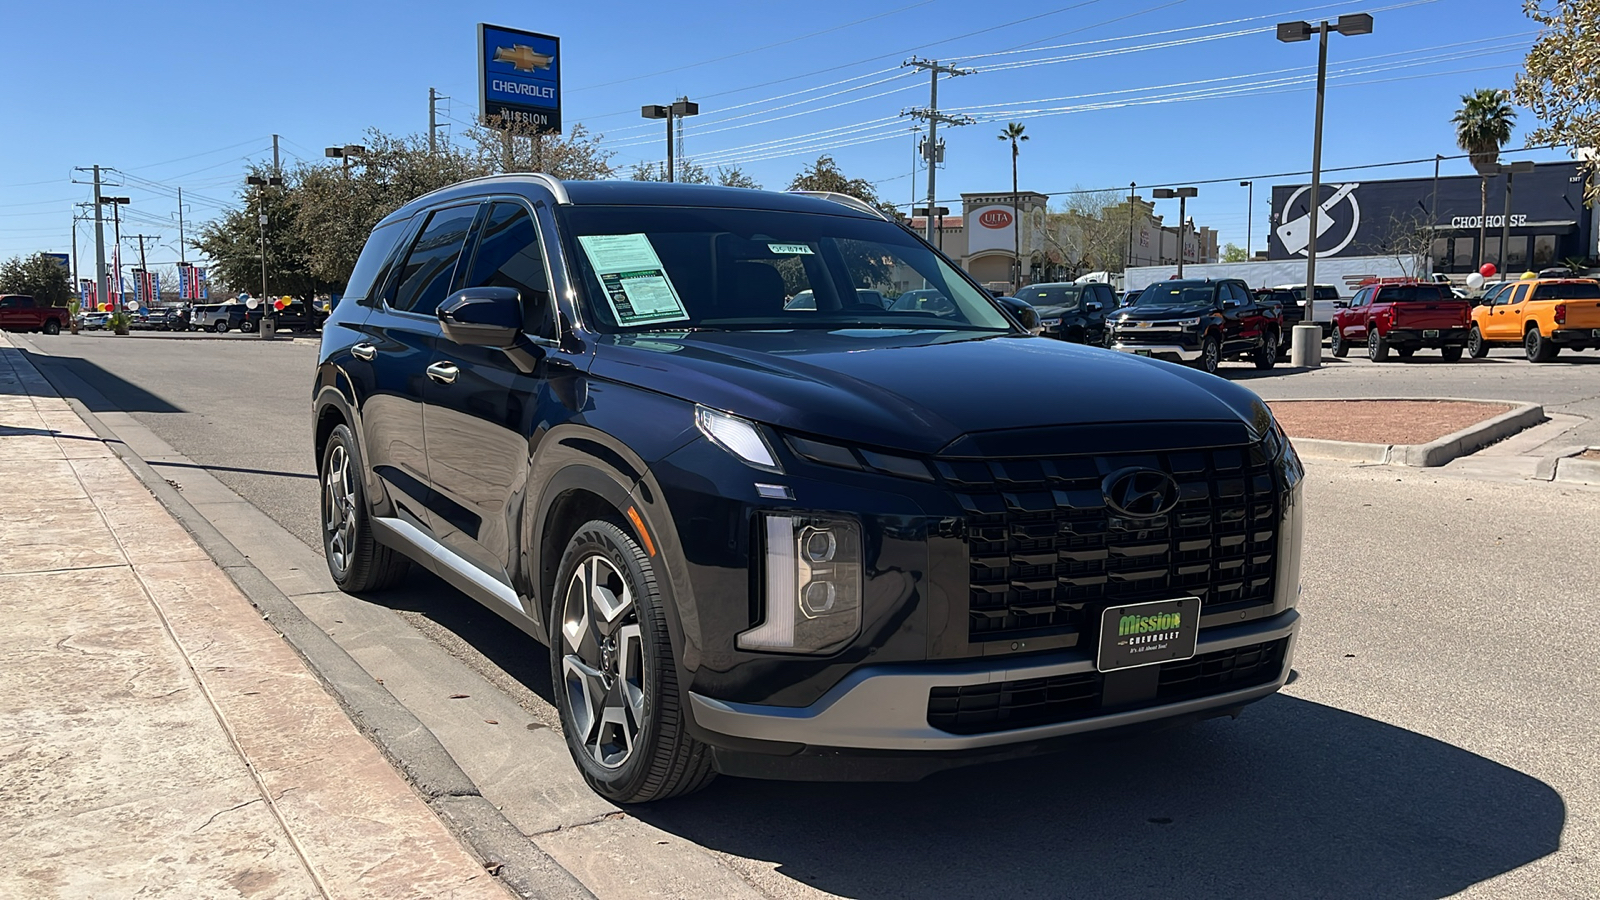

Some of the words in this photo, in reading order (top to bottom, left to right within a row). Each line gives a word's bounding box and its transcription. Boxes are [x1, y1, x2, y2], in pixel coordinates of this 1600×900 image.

[492, 80, 555, 98] CHEVROLET
[502, 110, 548, 125] MISSION
[985, 213, 1008, 222] ULTA
[1118, 612, 1181, 636] Mission
[1129, 631, 1180, 646] CHEVROLET
